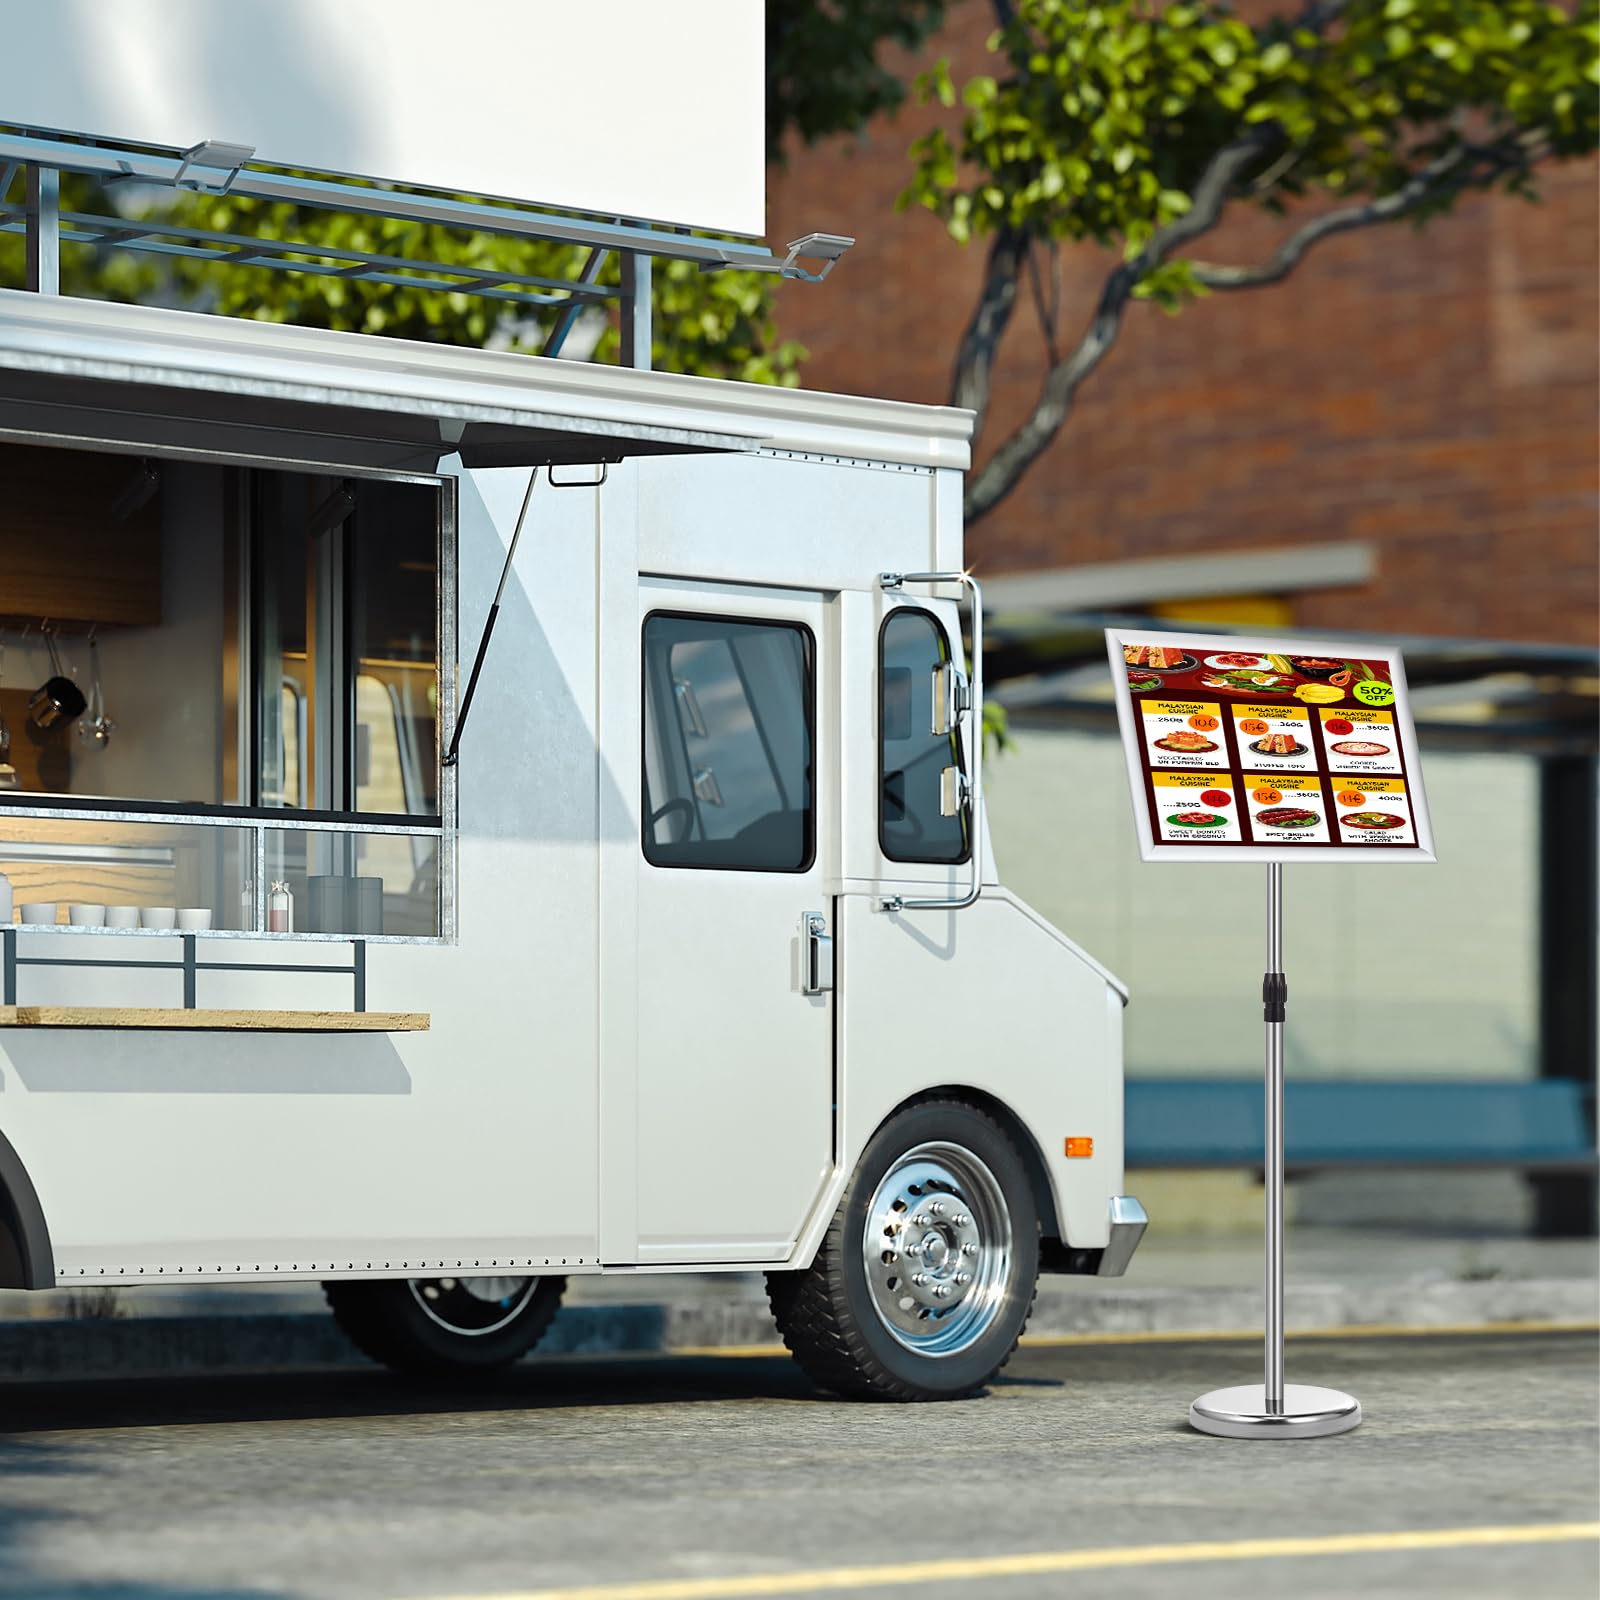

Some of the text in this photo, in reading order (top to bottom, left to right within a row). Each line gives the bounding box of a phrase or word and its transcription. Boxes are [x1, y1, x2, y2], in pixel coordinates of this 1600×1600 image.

[1360, 686, 1392, 696] 50%
[1194, 718, 1216, 727] 10€
[1244, 722, 1264, 732] 15€
[1257, 792, 1277, 801] 15€
